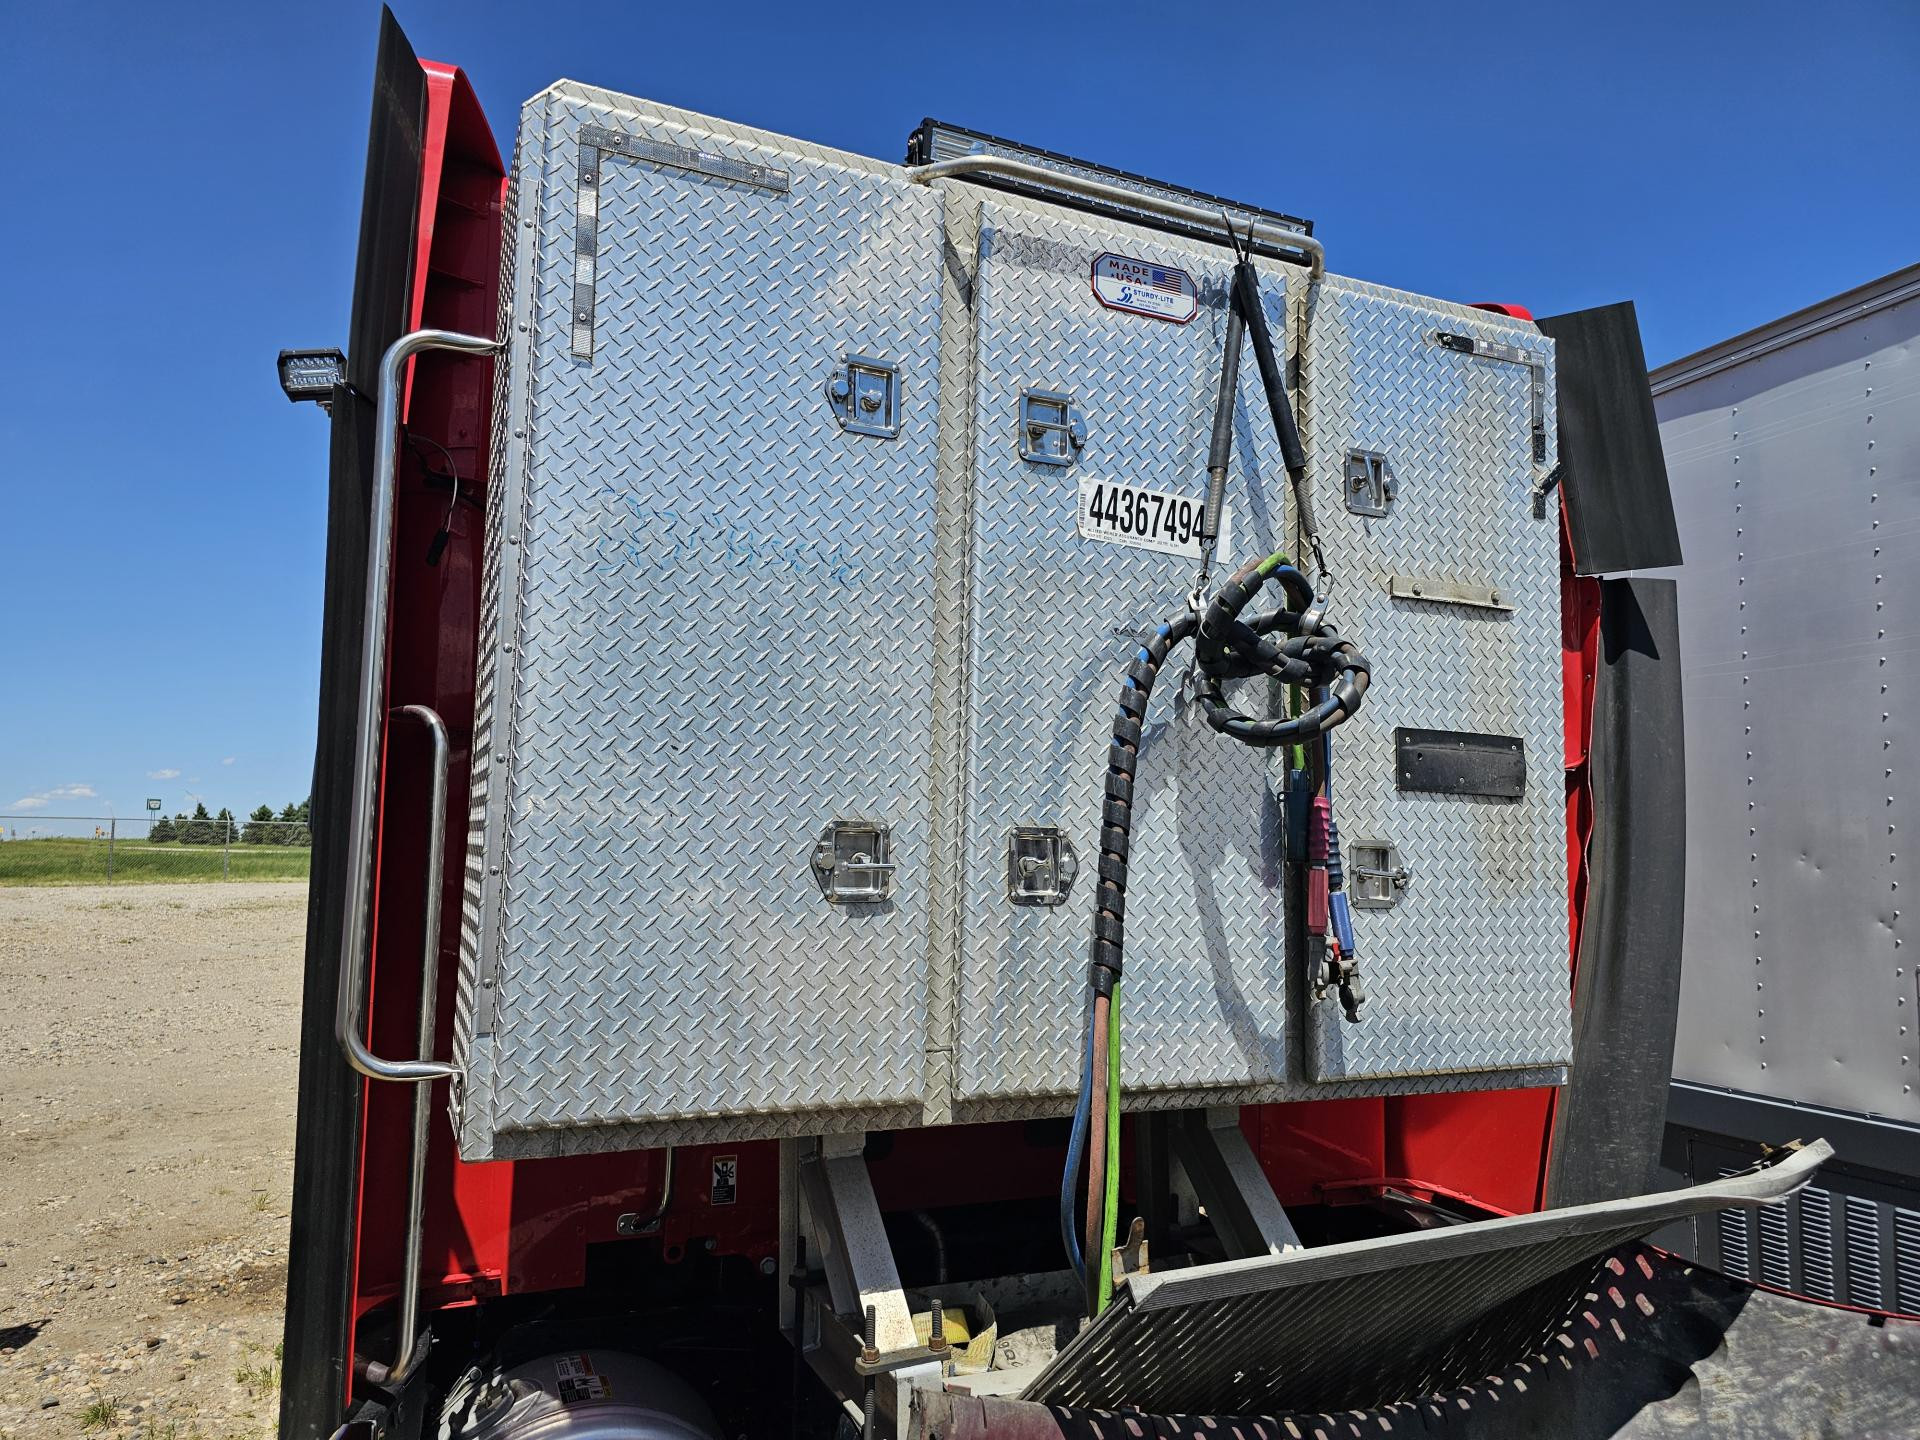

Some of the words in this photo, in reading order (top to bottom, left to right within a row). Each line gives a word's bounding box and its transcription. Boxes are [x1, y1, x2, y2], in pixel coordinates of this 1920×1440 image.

[1109, 260, 1149, 277] MADE
[1116, 272, 1142, 286] USA
[1133, 289, 1174, 304] STURDY-LITE
[1089, 484, 1205, 547] 44367494
